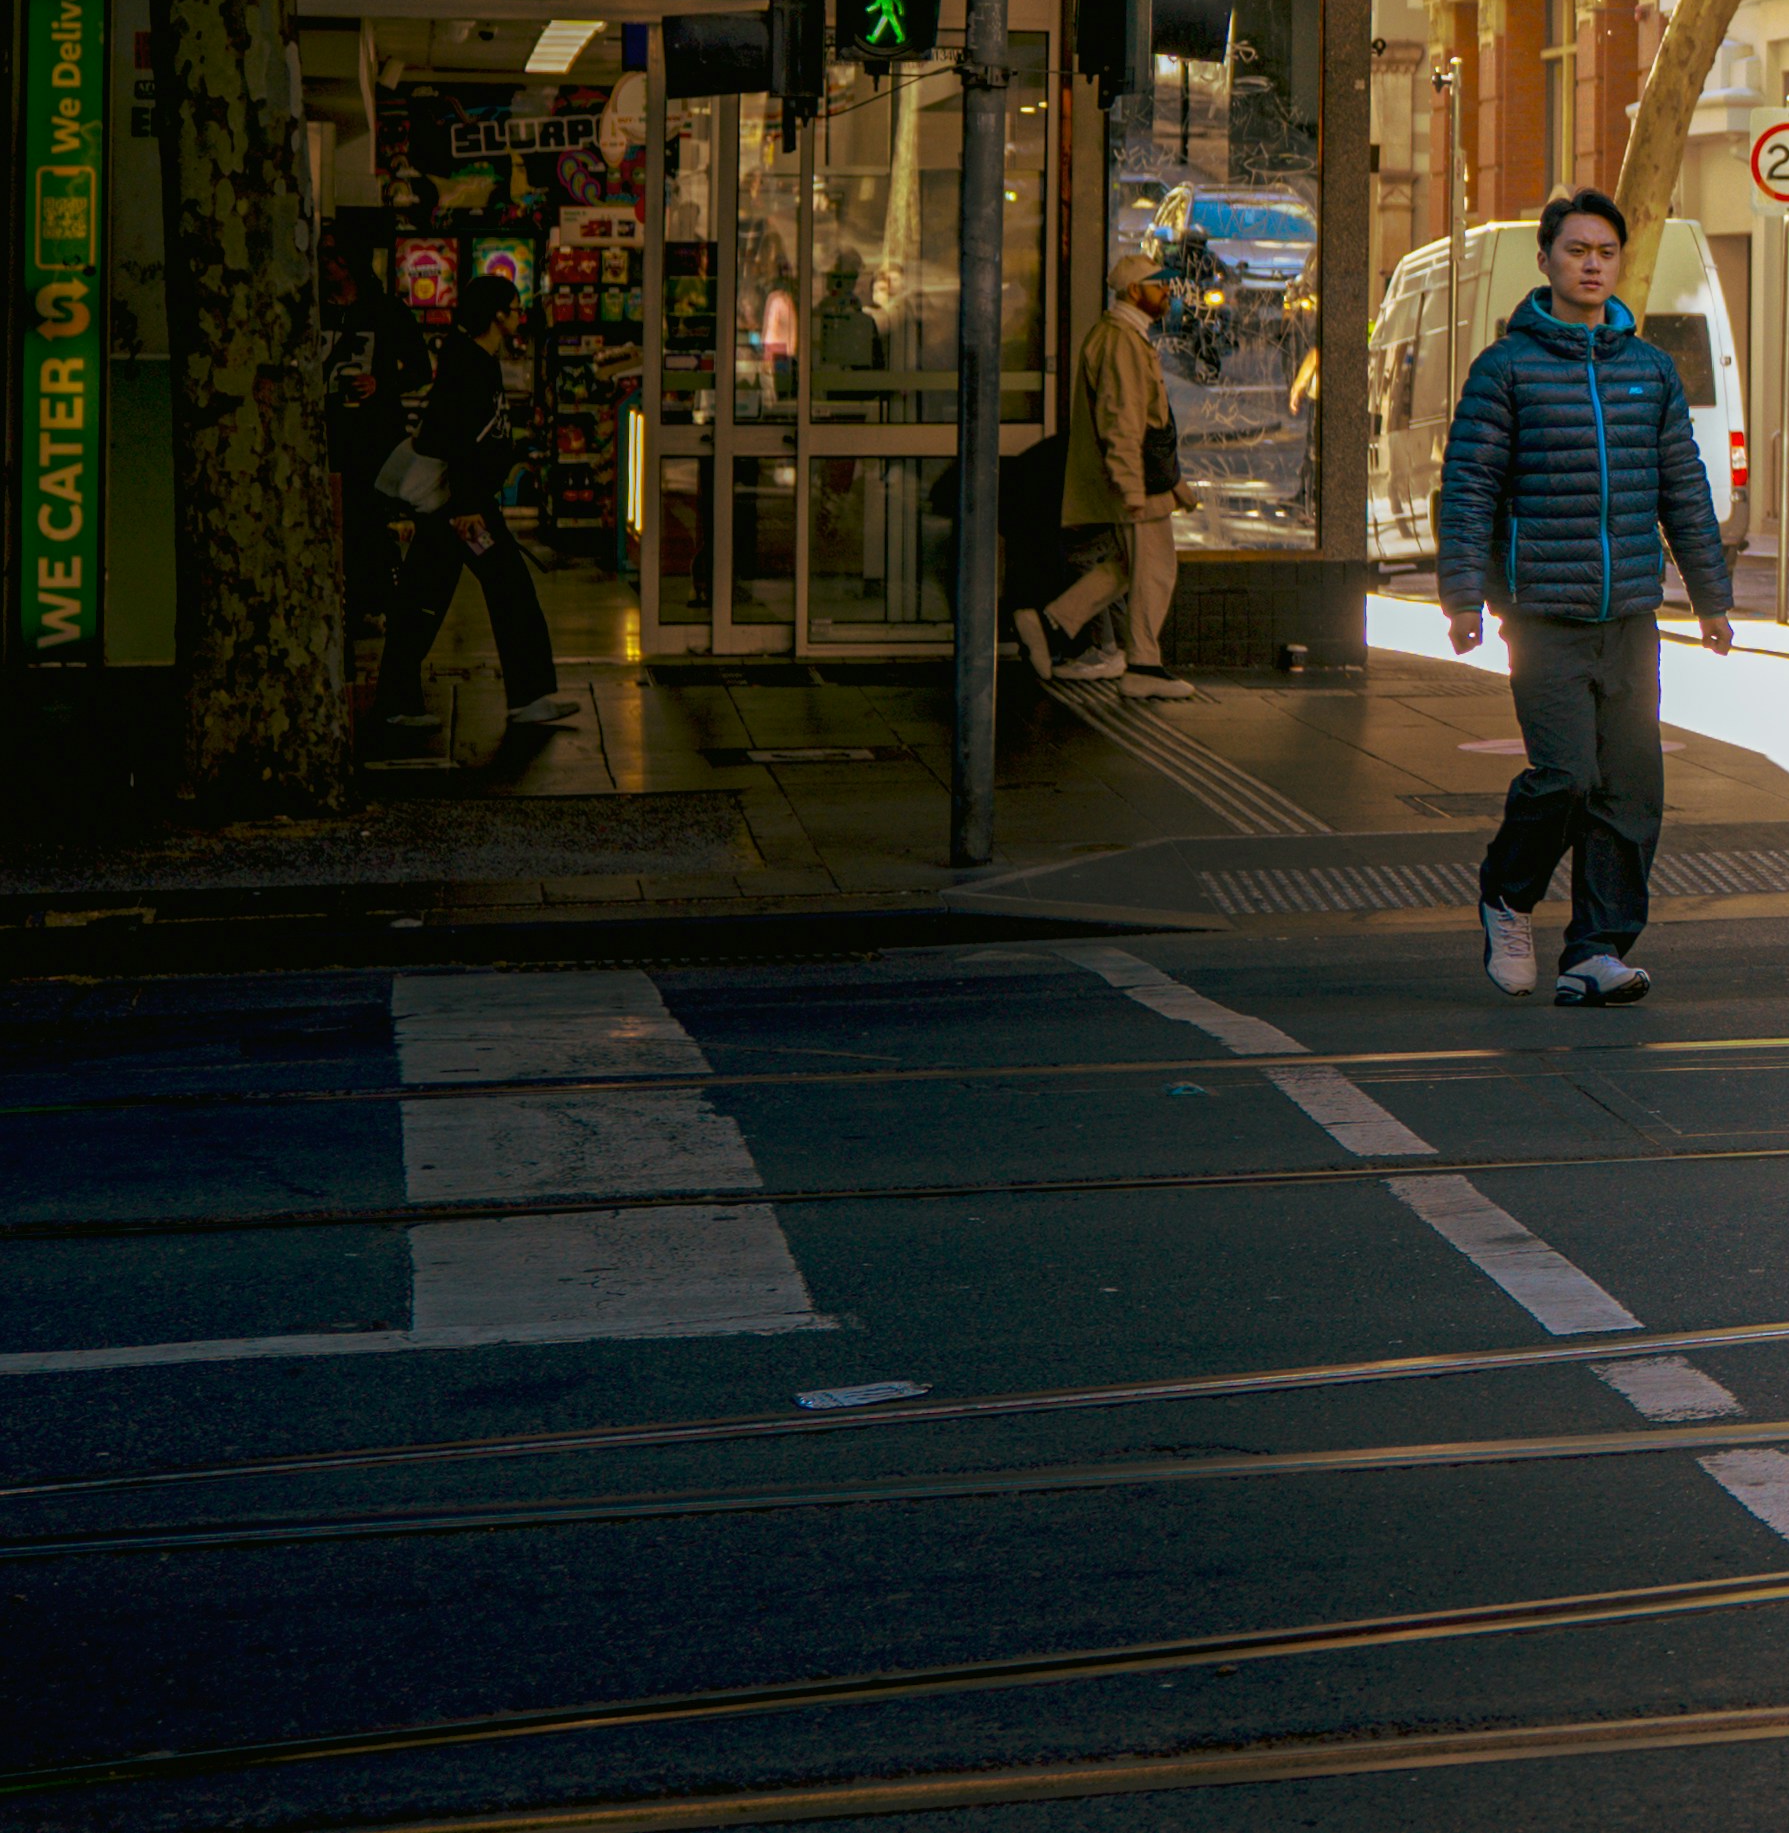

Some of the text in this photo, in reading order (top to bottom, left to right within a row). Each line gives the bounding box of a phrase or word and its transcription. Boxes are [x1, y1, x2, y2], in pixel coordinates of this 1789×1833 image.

[51, 97, 82, 154] We
[37, 357, 84, 649] WE CATER
